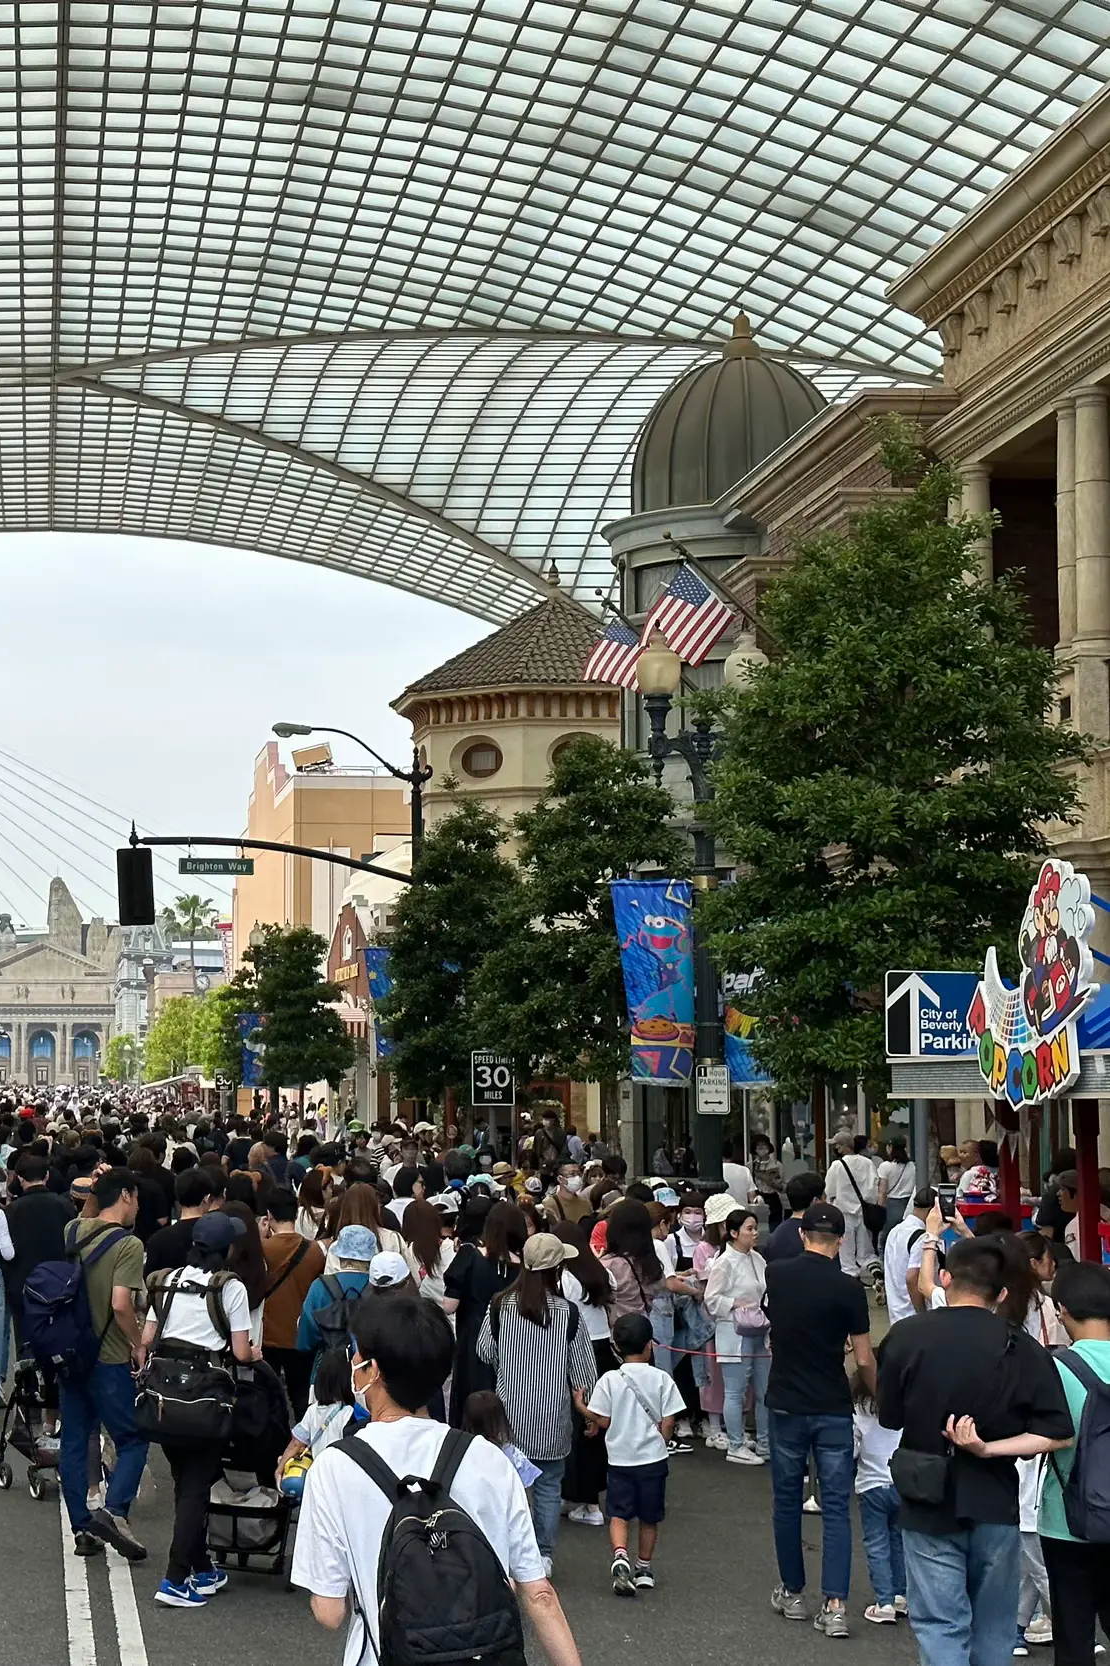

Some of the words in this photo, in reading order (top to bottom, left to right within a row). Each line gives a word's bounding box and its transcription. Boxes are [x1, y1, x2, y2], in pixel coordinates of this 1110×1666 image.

[186, 862, 223, 872] Brighton
[228, 862, 247, 871] Way
[920, 1008, 942, 1021] City
[945, 1008, 957, 1019] of
[920, 1019, 962, 1032] Beverly
[921, 1032, 978, 1050] Parkin
[968, 987, 1070, 1106] POPCORN
[474, 1055, 494, 1064] SPEED
[476, 1065, 510, 1088] 30
[700, 1078, 727, 1086] PARKING
[484, 1090, 503, 1100] MILES
